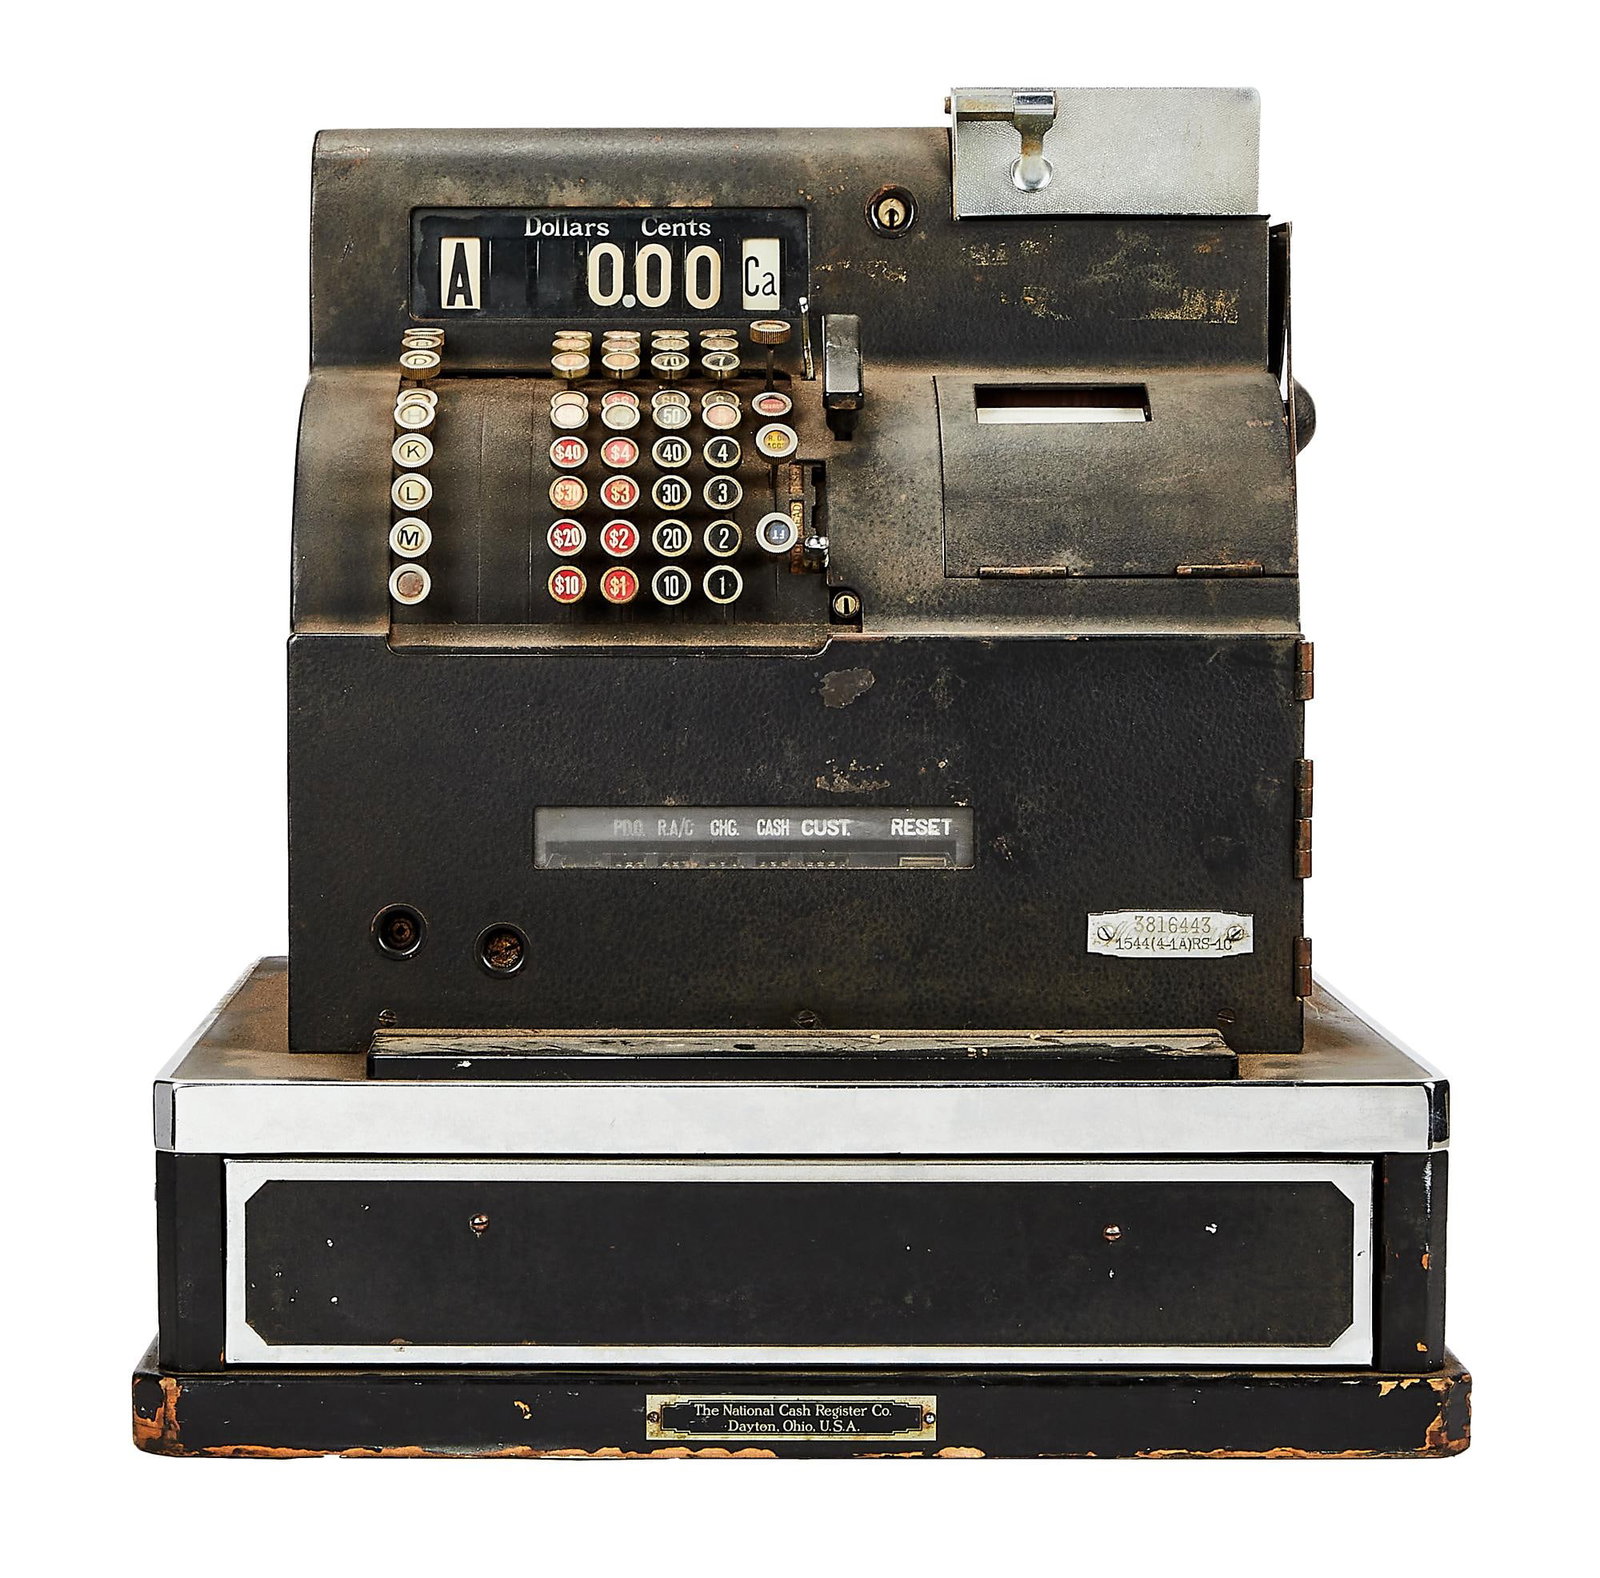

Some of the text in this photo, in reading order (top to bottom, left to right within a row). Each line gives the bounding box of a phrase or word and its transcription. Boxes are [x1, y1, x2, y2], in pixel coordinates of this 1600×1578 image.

[524, 217, 711, 237] Dollars Cents
[447, 242, 473, 307] A
[744, 255, 778, 297] Ca
[413, 357, 427, 365] D
[662, 356, 680, 367] 70
[717, 355, 725, 367] 7
[663, 409, 681, 424] 50
[407, 445, 420, 458] K
[555, 445, 581, 461] $40
[611, 446, 630, 461] $4
[662, 445, 681, 461] 40
[717, 445, 729, 461] 4
[406, 486, 419, 501] L
[555, 484, 581, 501] $30
[611, 484, 630, 502] $3
[662, 484, 681, 503] 30
[718, 483, 728, 503] 3
[400, 529, 419, 546] M
[553, 528, 580, 547] $20
[609, 528, 629, 548] $2
[662, 528, 682, 549] 20
[719, 528, 729, 549] 2
[555, 575, 579, 596] $10
[610, 576, 627, 597] $1
[663, 576, 680, 597] 10
[719, 576, 726, 596] 1
[710, 819, 740, 837] CHG.
[756, 818, 790, 837] CASH
[801, 818, 851, 837] CUST.
[890, 818, 952, 837] RESET
[1134, 915, 1212, 934] 3816443
[694, 1403, 893, 1421] The National Cash Register Co.
[819, 1420, 861, 1433] U.S.A.
